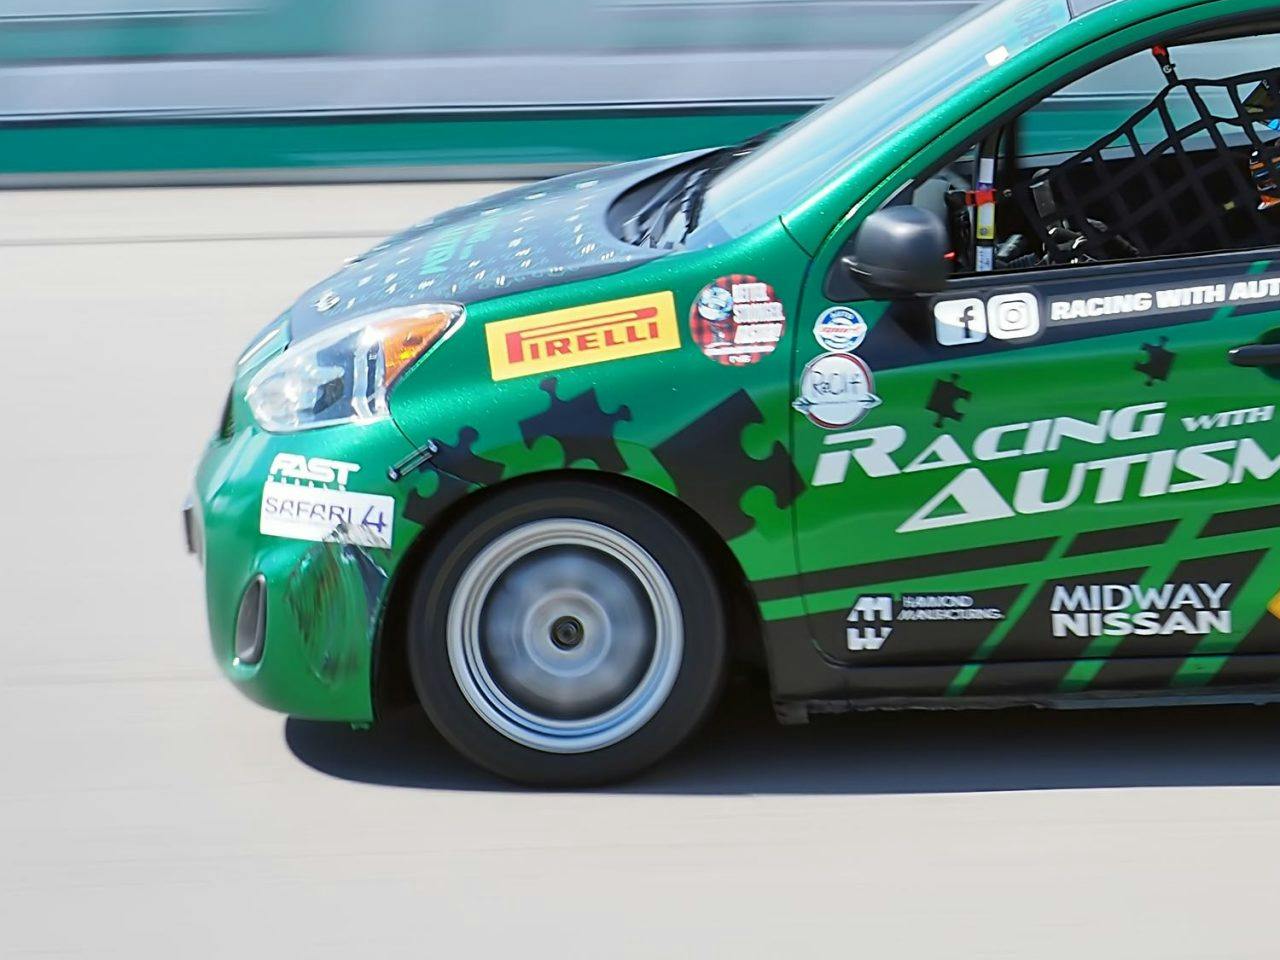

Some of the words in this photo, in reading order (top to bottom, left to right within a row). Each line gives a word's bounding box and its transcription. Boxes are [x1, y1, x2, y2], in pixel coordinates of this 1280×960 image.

[1050, 292, 1153, 321] RACING
[1155, 284, 1226, 309] WITH
[505, 306, 658, 364] PIRELLI
[811, 402, 1167, 486] RACING
[1181, 405, 1275, 433] WITH
[269, 451, 361, 486] FAST
[361, 504, 388, 533] 4
[1050, 583, 1231, 611] MIDWAY
[1052, 610, 1232, 637] NISSAN
